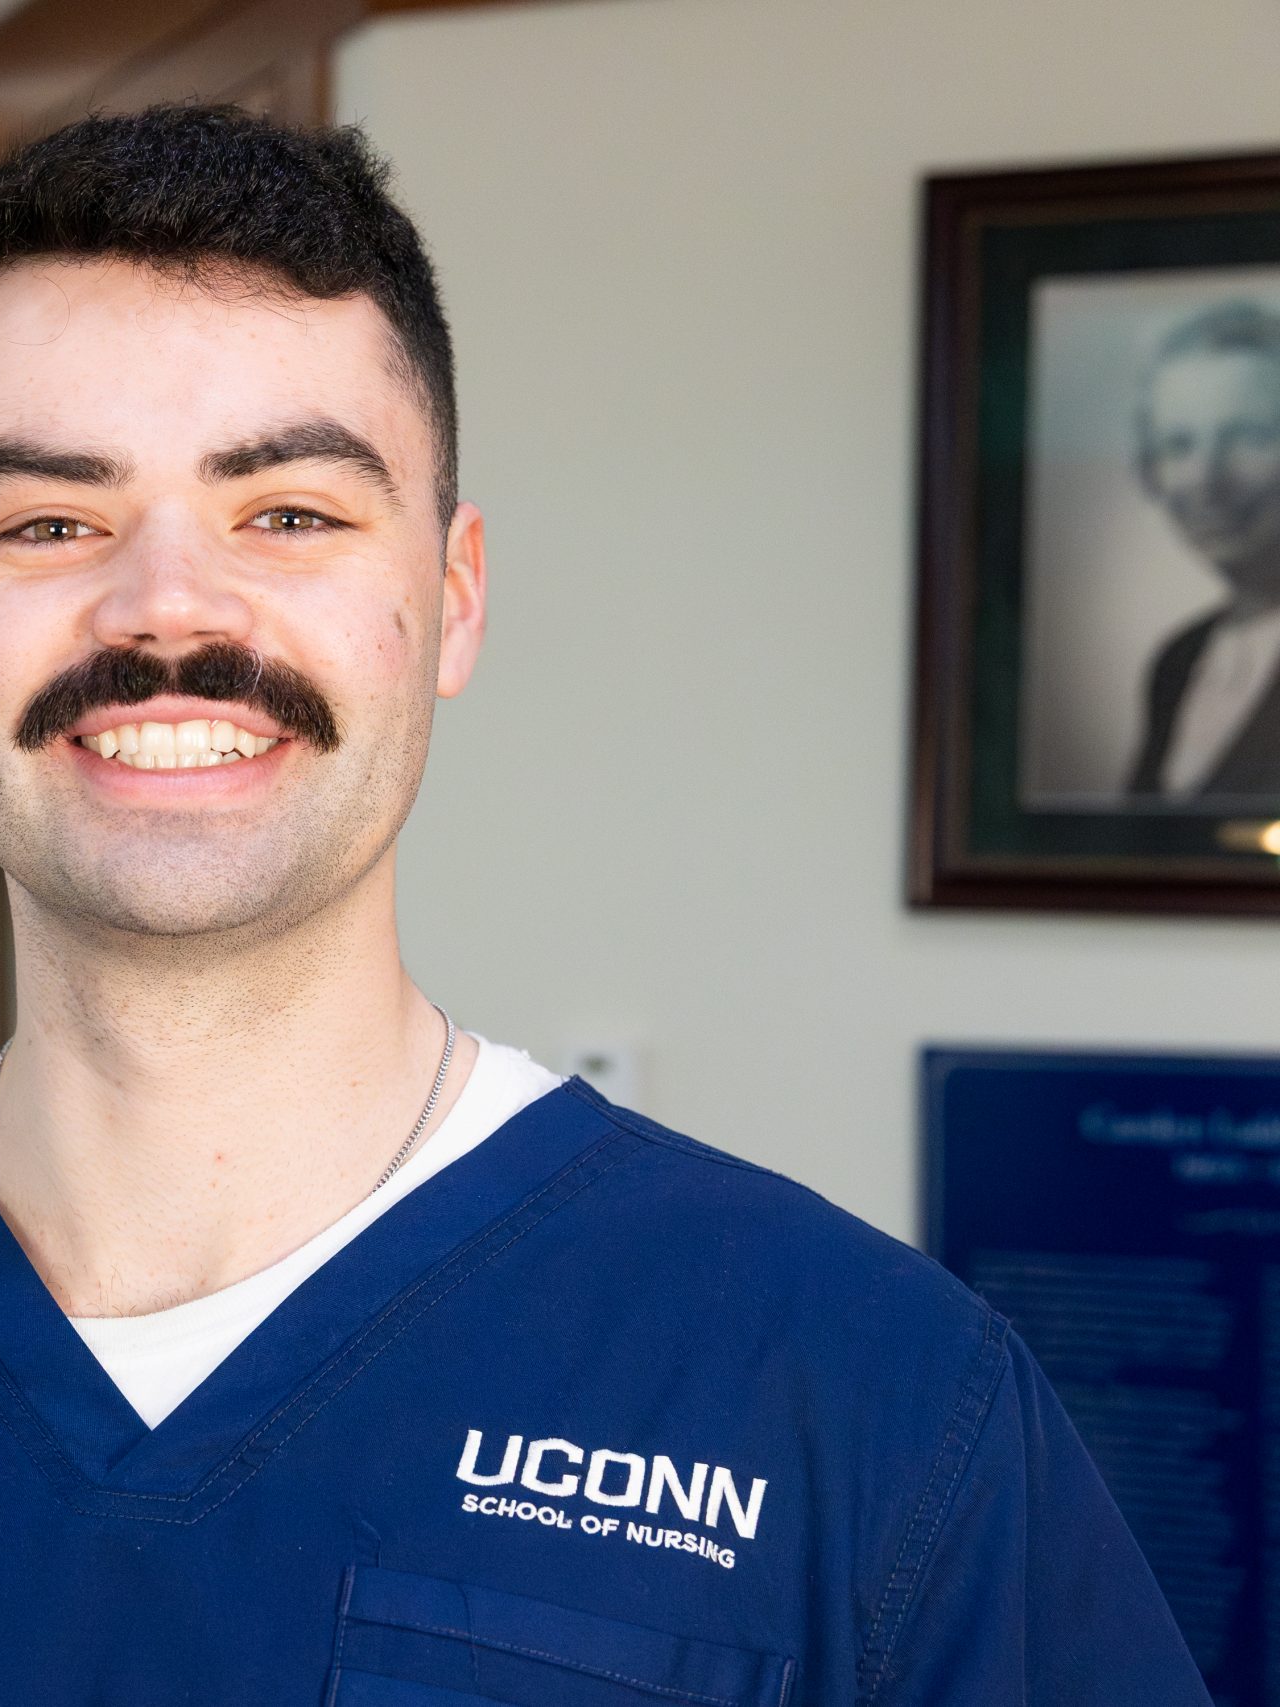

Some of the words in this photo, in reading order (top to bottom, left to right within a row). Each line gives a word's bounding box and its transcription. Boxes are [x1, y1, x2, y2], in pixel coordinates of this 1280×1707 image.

[456, 1429, 768, 1540] UCONN
[461, 1493, 573, 1529] SCHOOL
[580, 1514, 620, 1537] OF
[626, 1521, 736, 1570] NURSING
